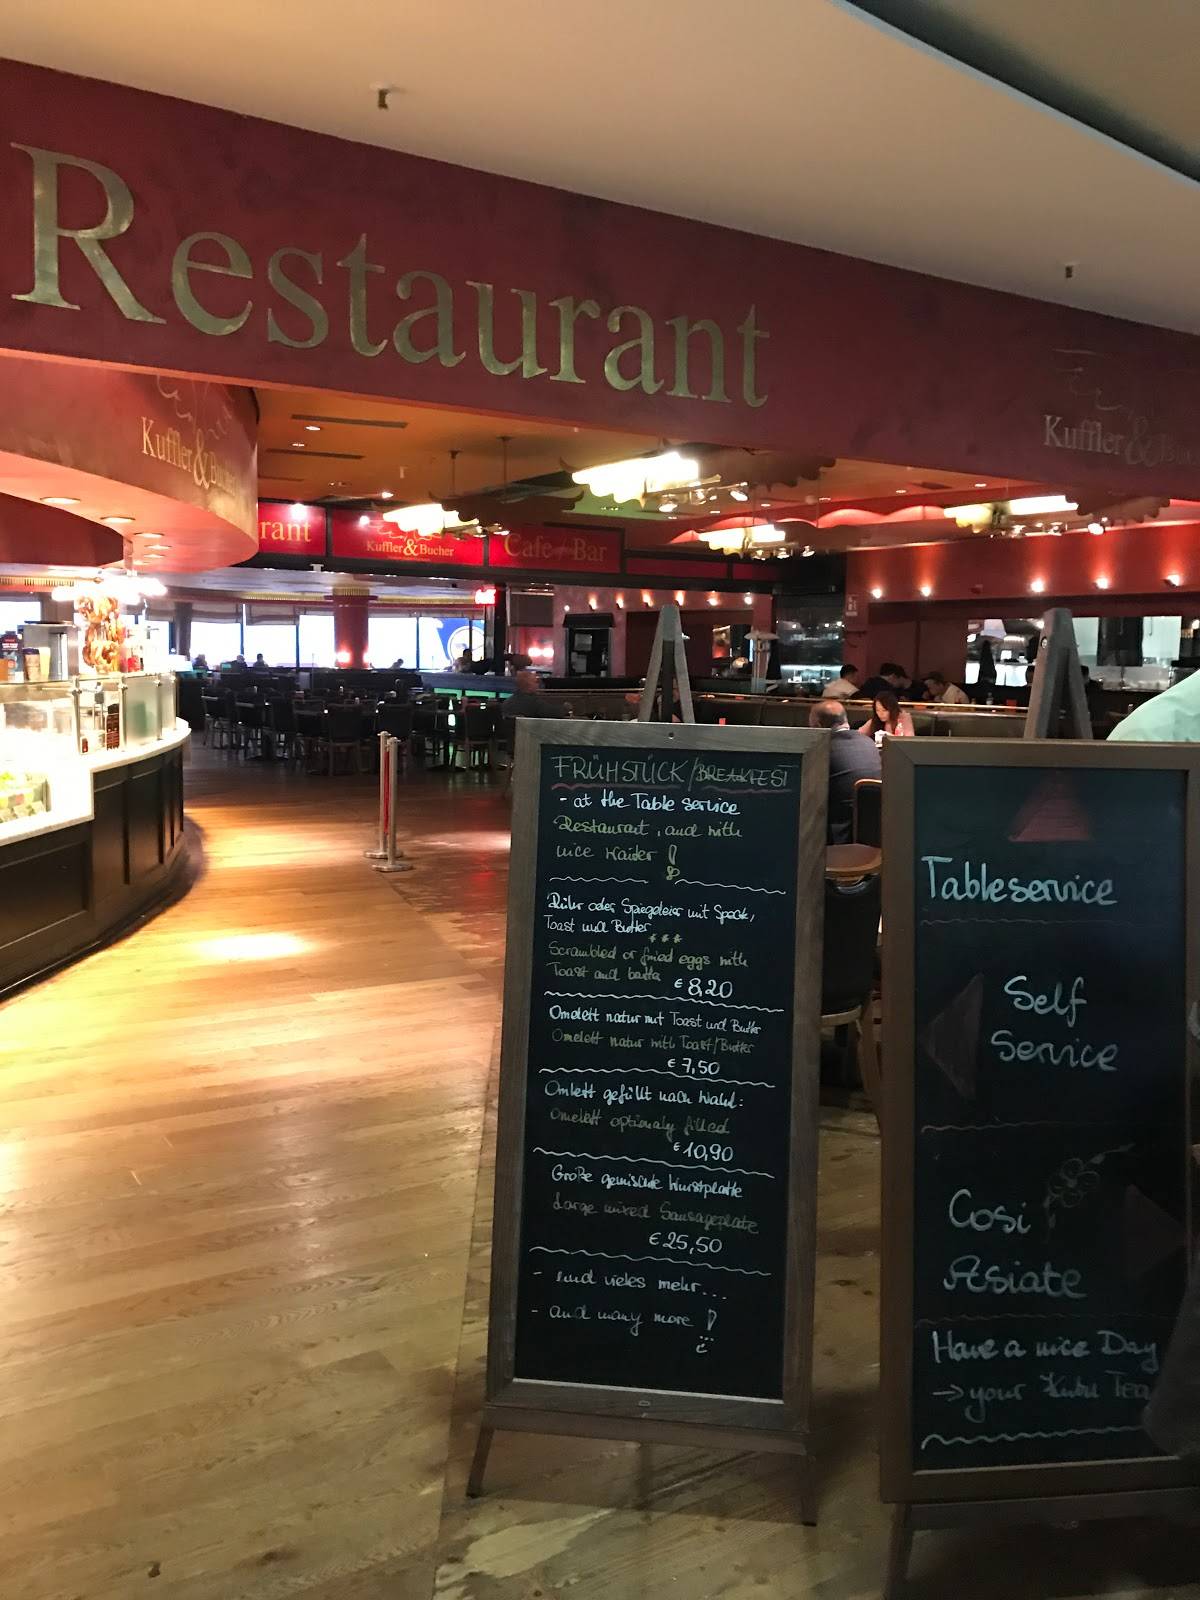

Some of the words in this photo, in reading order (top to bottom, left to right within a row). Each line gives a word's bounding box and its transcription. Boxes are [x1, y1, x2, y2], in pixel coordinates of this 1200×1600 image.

[10, 141, 769, 408] Restaurant
[574, 793, 592, 808] at
[601, 789, 630, 808] the
[631, 792, 675, 811] Table
[708, 821, 742, 838] with
[921, 855, 1118, 905] Tableservice
[544, 914, 575, 933] Toast
[688, 903, 709, 920] mit
[549, 941, 616, 960] Scrambled
[679, 951, 711, 970] eggs
[547, 961, 588, 978] Toast
[594, 967, 620, 980] and
[1004, 974, 1087, 1028] Self
[606, 1010, 641, 1024] natur
[669, 1012, 702, 1028] Toast
[610, 1034, 644, 1049] natur
[991, 1029, 1119, 1071] Service
[949, 1188, 1031, 1234] Cosi
[943, 1254, 1088, 1298] Asiate
[654, 1310, 694, 1327] more
[932, 1330, 999, 1364] Have
[1004, 1339, 1027, 1359] a
[1036, 1337, 1090, 1359] nice
[1096, 1330, 1160, 1375] Day
[964, 1384, 1027, 1424] your
